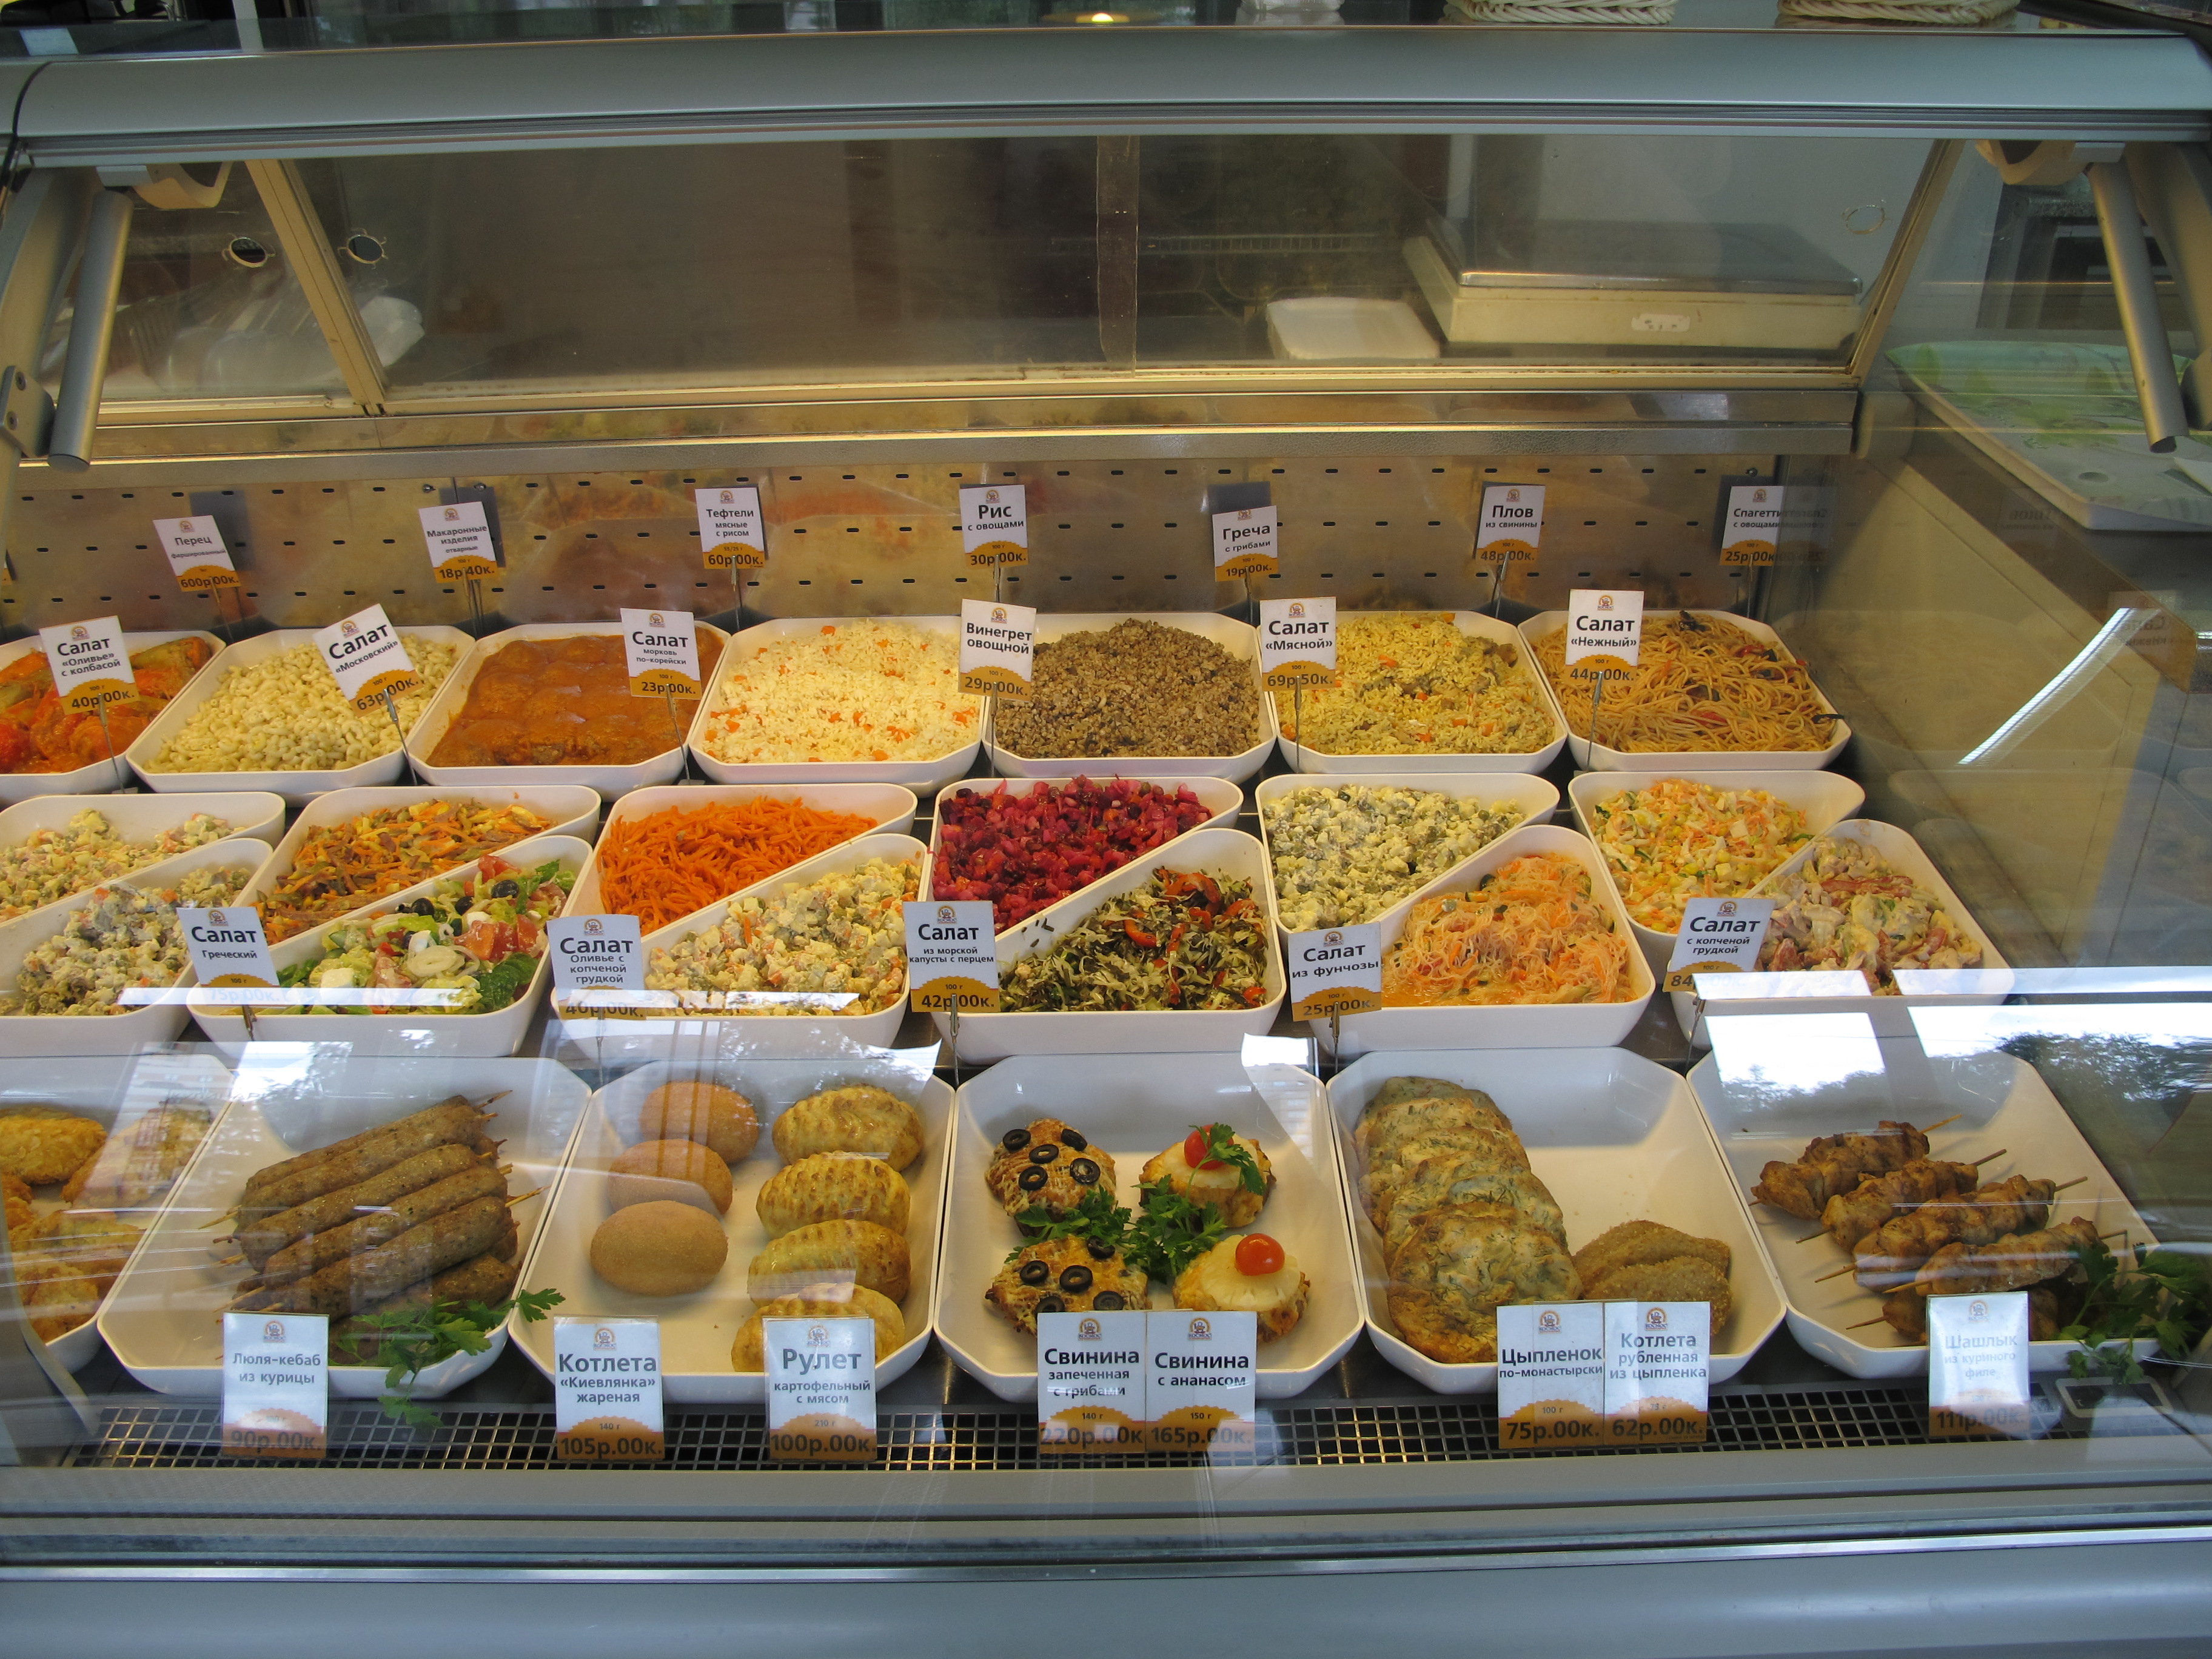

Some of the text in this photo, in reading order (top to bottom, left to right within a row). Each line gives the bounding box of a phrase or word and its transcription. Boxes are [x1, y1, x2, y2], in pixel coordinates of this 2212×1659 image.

[706, 509, 754, 519] Тефтели
[978, 504, 1012, 519] Рис
[1492, 505, 1534, 518] Плов
[427, 526, 488, 537] Макаронные
[976, 521, 1024, 531] овощами
[1223, 525, 1270, 541] Греча
[175, 537, 212, 546] Перец
[441, 535, 478, 545] изделия
[1233, 541, 1271, 552] грибами
[708, 554, 763, 567] 60р00к.
[970, 552, 1027, 566] 30р00к.
[1481, 551, 1535, 563] 48р00к.
[1725, 551, 1774, 563] 25р00к
[439, 565, 495, 579] 18р40к.
[1226, 564, 1272, 577] 19р00к.
[180, 575, 239, 588] 600р00к.
[1269, 620, 1329, 635] Салат
[1577, 615, 1635, 631] Салат
[632, 631, 688, 647] Салат
[967, 623, 1032, 641] Винегрет
[58, 638, 110, 655] Салат
[329, 625, 388, 659] Салат
[967, 639, 1029, 654] овощной
[1265, 638, 1333, 650] «Мясной»
[1571, 637, 1637, 647] «Нежный»
[62, 653, 114, 666] «Оливье»
[336, 641, 398, 672] «Московский»
[70, 659, 121, 675] колбасой
[1267, 674, 1333, 688] 69р50к.
[1570, 668, 1634, 683] 44р00к.
[642, 682, 695, 694] 23р00к.
[965, 677, 1028, 695] 29р00к.
[72, 691, 135, 708] 40р00к.
[357, 678, 418, 710] 63р00к.
[918, 923, 979, 940] Салат
[1690, 917, 1760, 932] Салат
[192, 926, 256, 943] Салат
[560, 937, 633, 954] Салат
[937, 947, 977, 956] морской
[1692, 946, 1739, 955] грудкой
[203, 950, 257, 960] Греческий
[1304, 945, 1366, 962] Салат
[570, 965, 626, 973] копченой
[1313, 961, 1379, 977] фунчозы
[576, 974, 623, 984] грудкой
[209, 988, 280, 1004] 75р00к.
[921, 994, 994, 1011] 42р00к.
[1304, 999, 1375, 1016] 25р00к.
[1621, 1333, 1696, 1348] Котлета
[1945, 1335, 2018, 1349] Шашлык
[233, 1353, 321, 1366] Люля-кебаб
[559, 1354, 656, 1372] Котлета
[782, 1349, 862, 1375] Рулет
[1045, 1349, 1139, 1364] Свинина
[1155, 1352, 1249, 1369] Свинина
[1502, 1348, 1602, 1366] Цыпленок
[1619, 1351, 1698, 1367] рубленная
[1945, 1352, 2016, 1364] из куриного
[240, 1372, 314, 1385] из курицы
[1048, 1370, 1130, 1380] запеченная
[1500, 1366, 1603, 1378] по-монастырски
[1610, 1368, 1706, 1380] из цыпленка
[1965, 1368, 1996, 1380] филе
[560, 1377, 655, 1388] «Киевлянка»
[774, 1380, 871, 1393] картофельный
[1158, 1376, 1246, 1386] с ананасом
[1065, 1384, 1125, 1398] грибами
[577, 1393, 640, 1405] жареная
[1507, 1420, 1600, 1444] 75р.00к.
[1612, 1418, 1703, 1441] 62р.00к.
[1151, 1427, 1252, 1448] 165р.00к.
[560, 1438, 662, 1459] 105р.00к.
[771, 1435, 876, 1456] 100р.00к.
